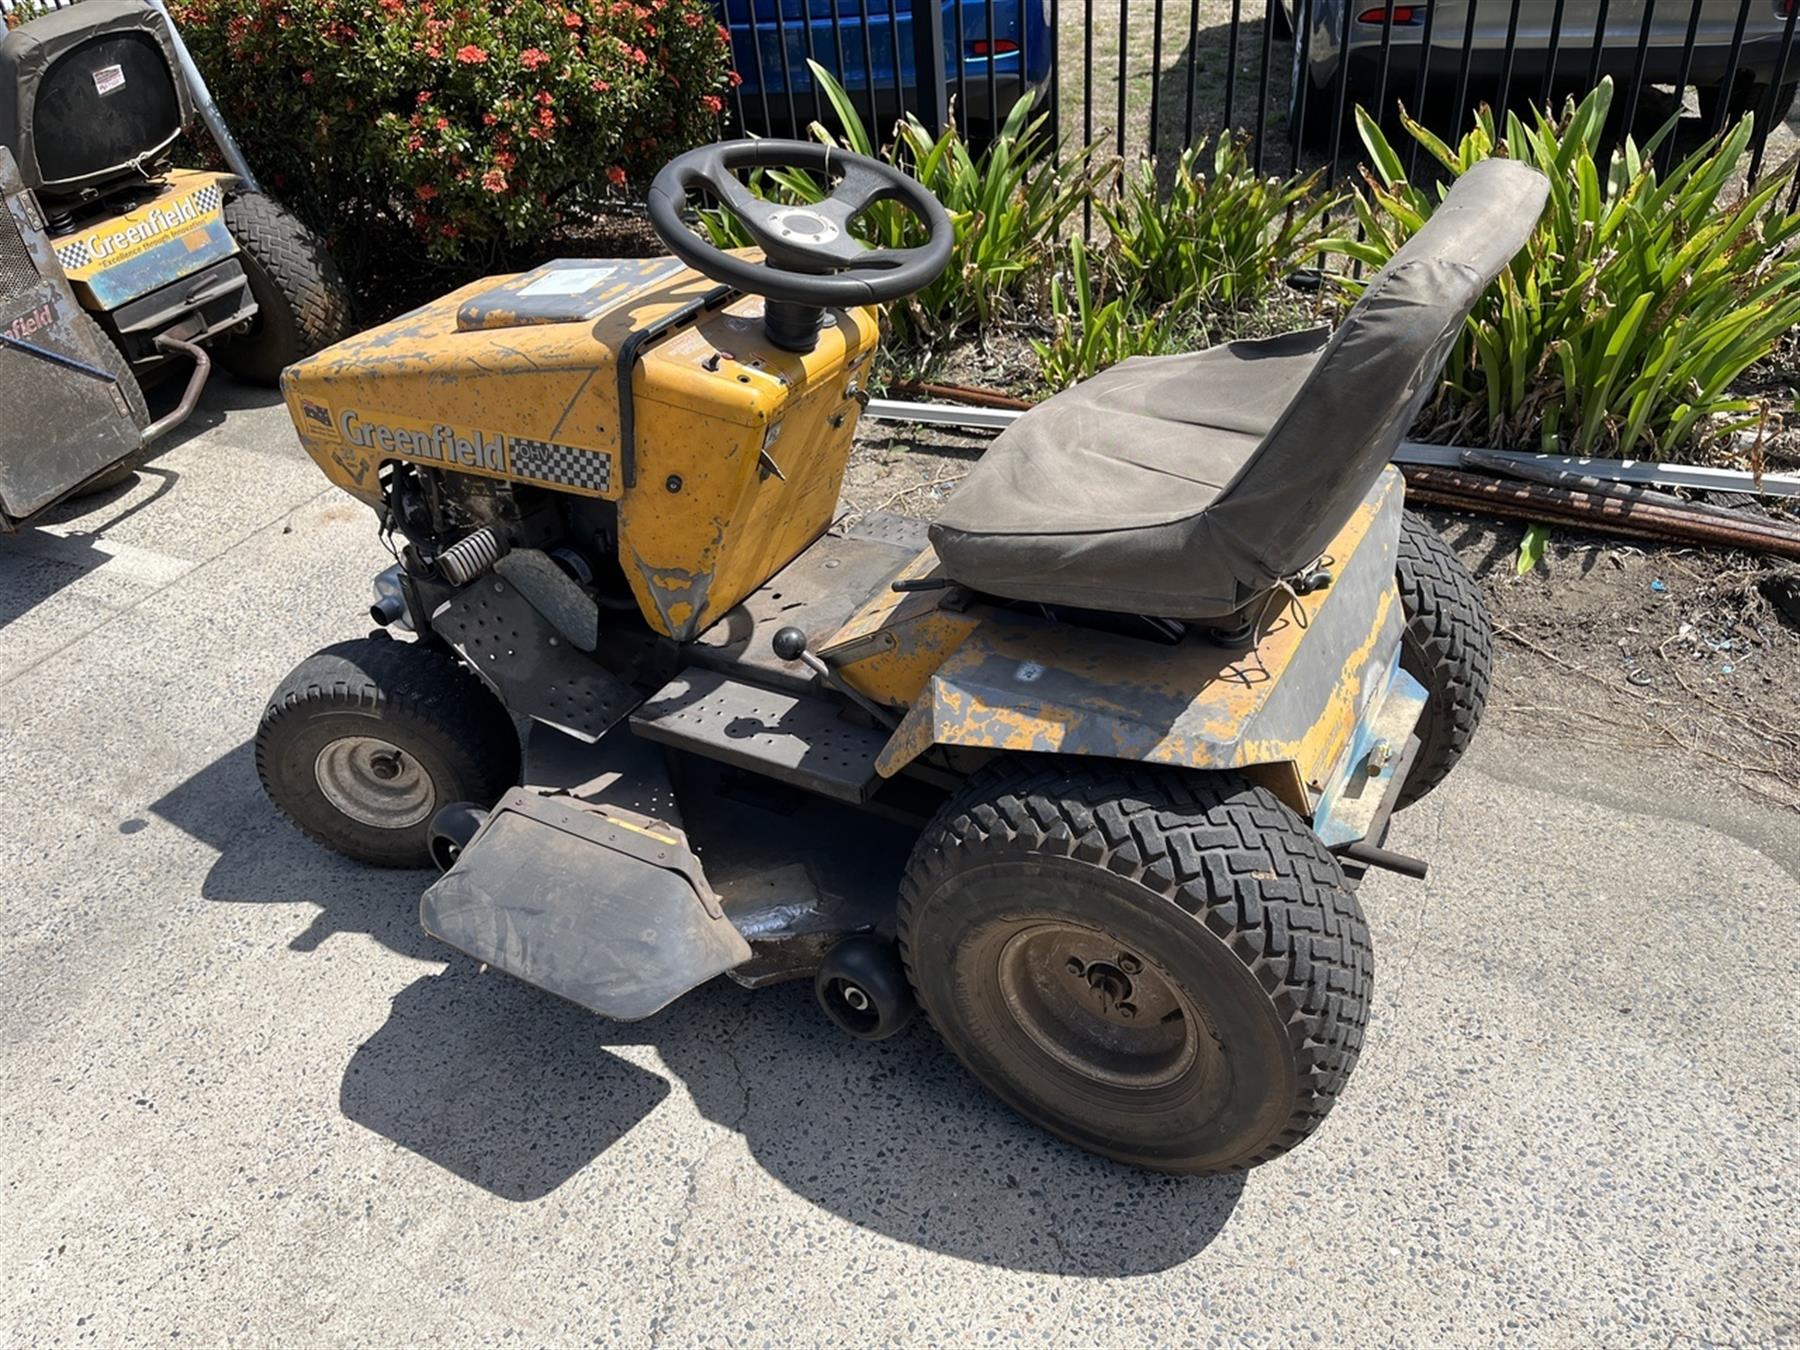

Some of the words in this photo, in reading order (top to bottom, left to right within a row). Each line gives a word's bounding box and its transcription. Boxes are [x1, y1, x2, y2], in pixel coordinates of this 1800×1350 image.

[87, 195, 199, 259] Greenfield
[340, 409, 506, 473] Greenfield
[520, 445, 549, 460] OHV
